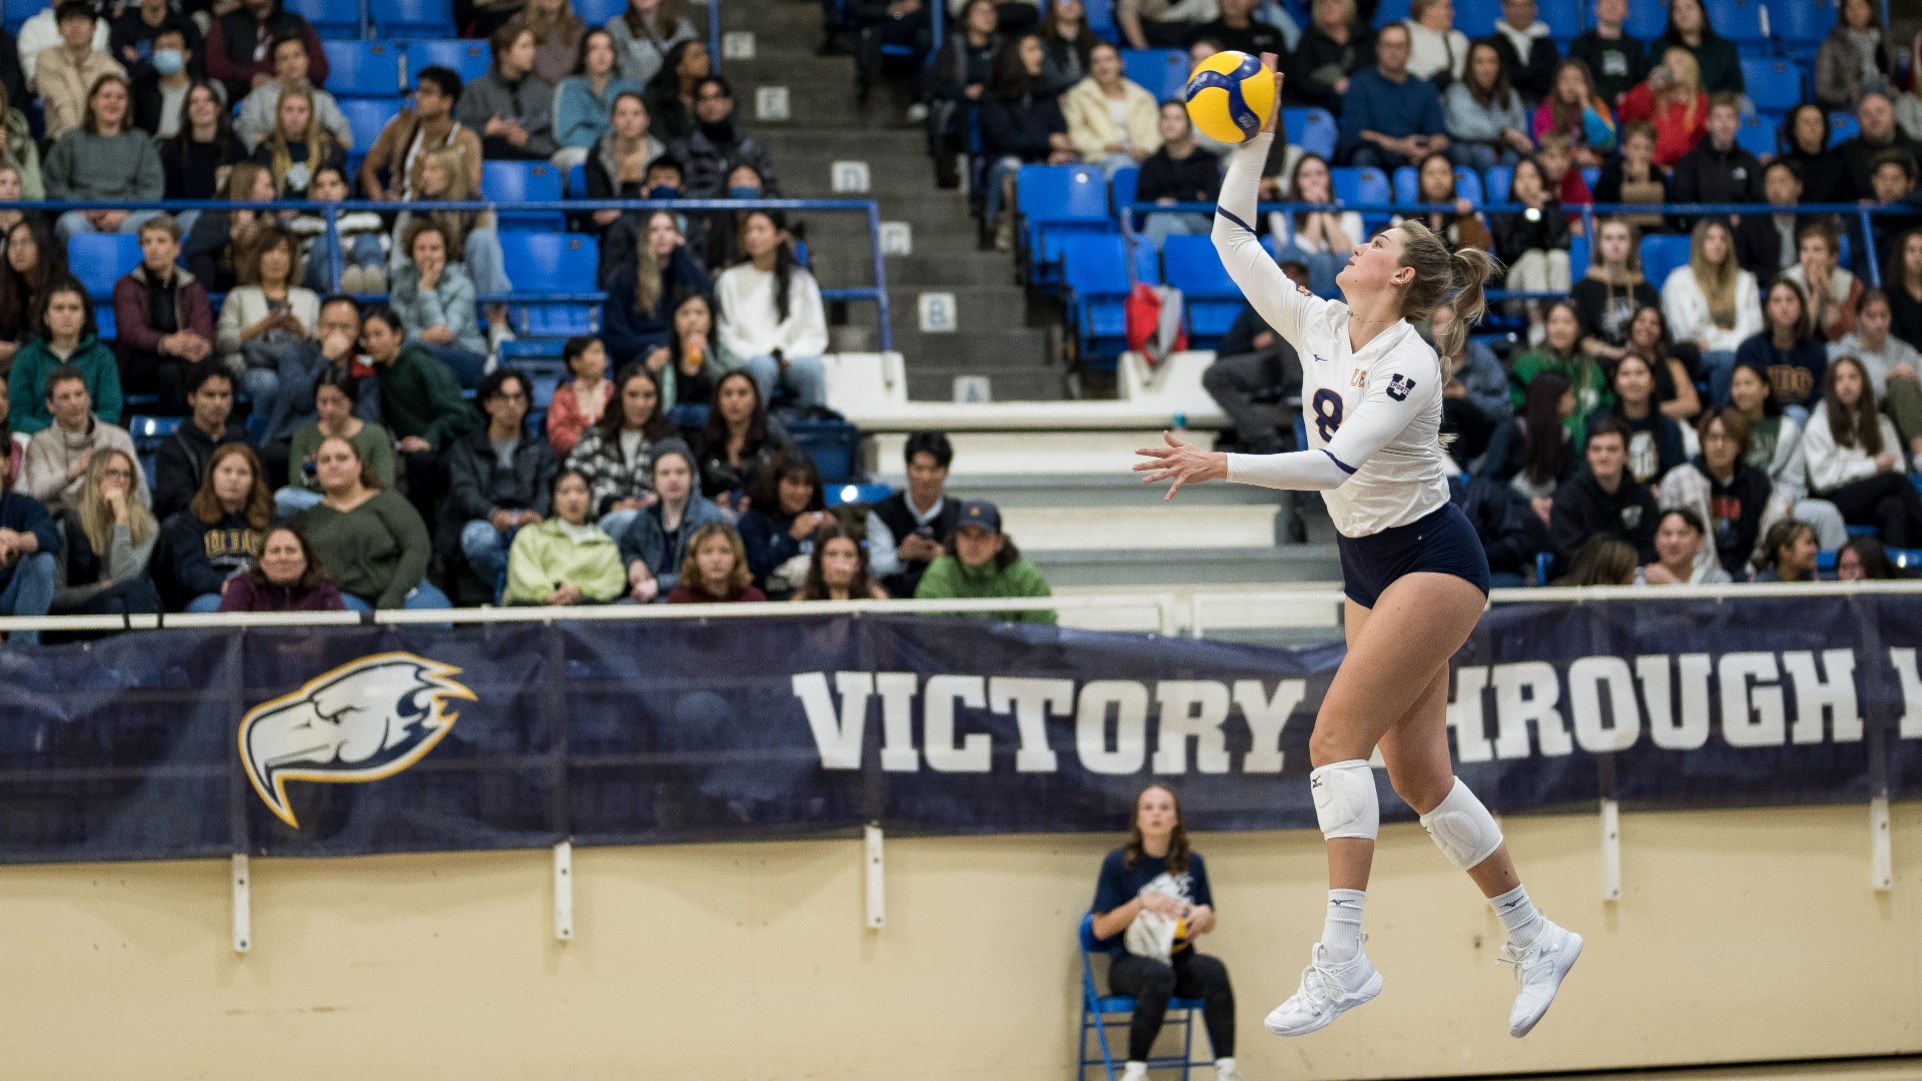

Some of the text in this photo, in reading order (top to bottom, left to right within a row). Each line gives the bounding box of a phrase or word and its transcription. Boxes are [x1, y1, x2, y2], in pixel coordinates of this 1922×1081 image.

[928, 298, 946, 327] B
[1385, 373, 1416, 402] U
[1389, 381, 1411, 396] SPORTS
[1312, 387, 1343, 444] 8
[791, 671, 1306, 775] VICTORY
[1369, 648, 1863, 768] HROUGH
